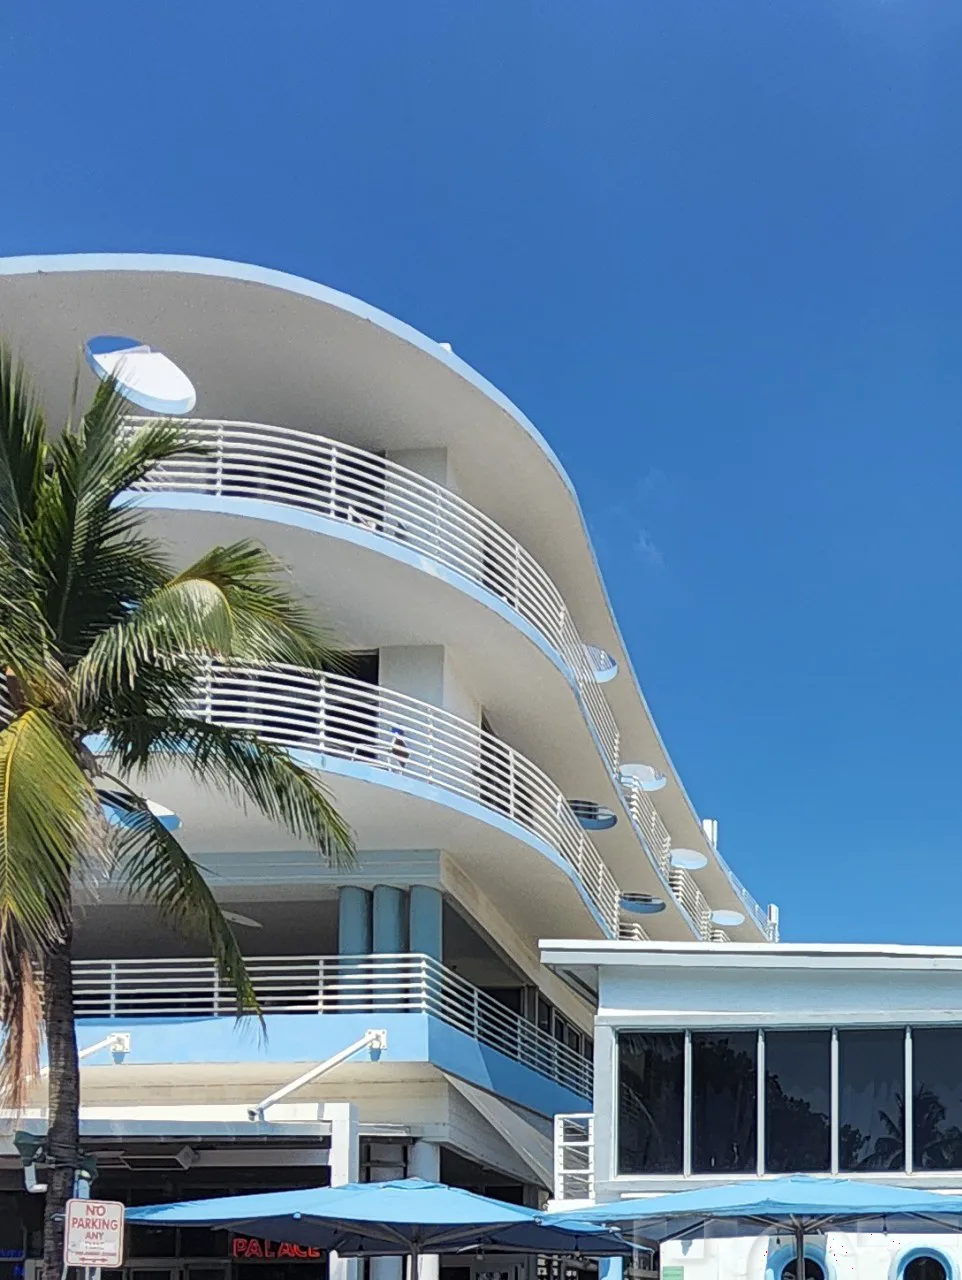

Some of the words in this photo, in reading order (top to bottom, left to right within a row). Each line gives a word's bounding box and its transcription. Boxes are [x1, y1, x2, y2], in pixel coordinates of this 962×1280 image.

[86, 1205, 106, 1216] NO
[72, 1217, 118, 1230] PARKING
[85, 1231, 104, 1240] ANY
